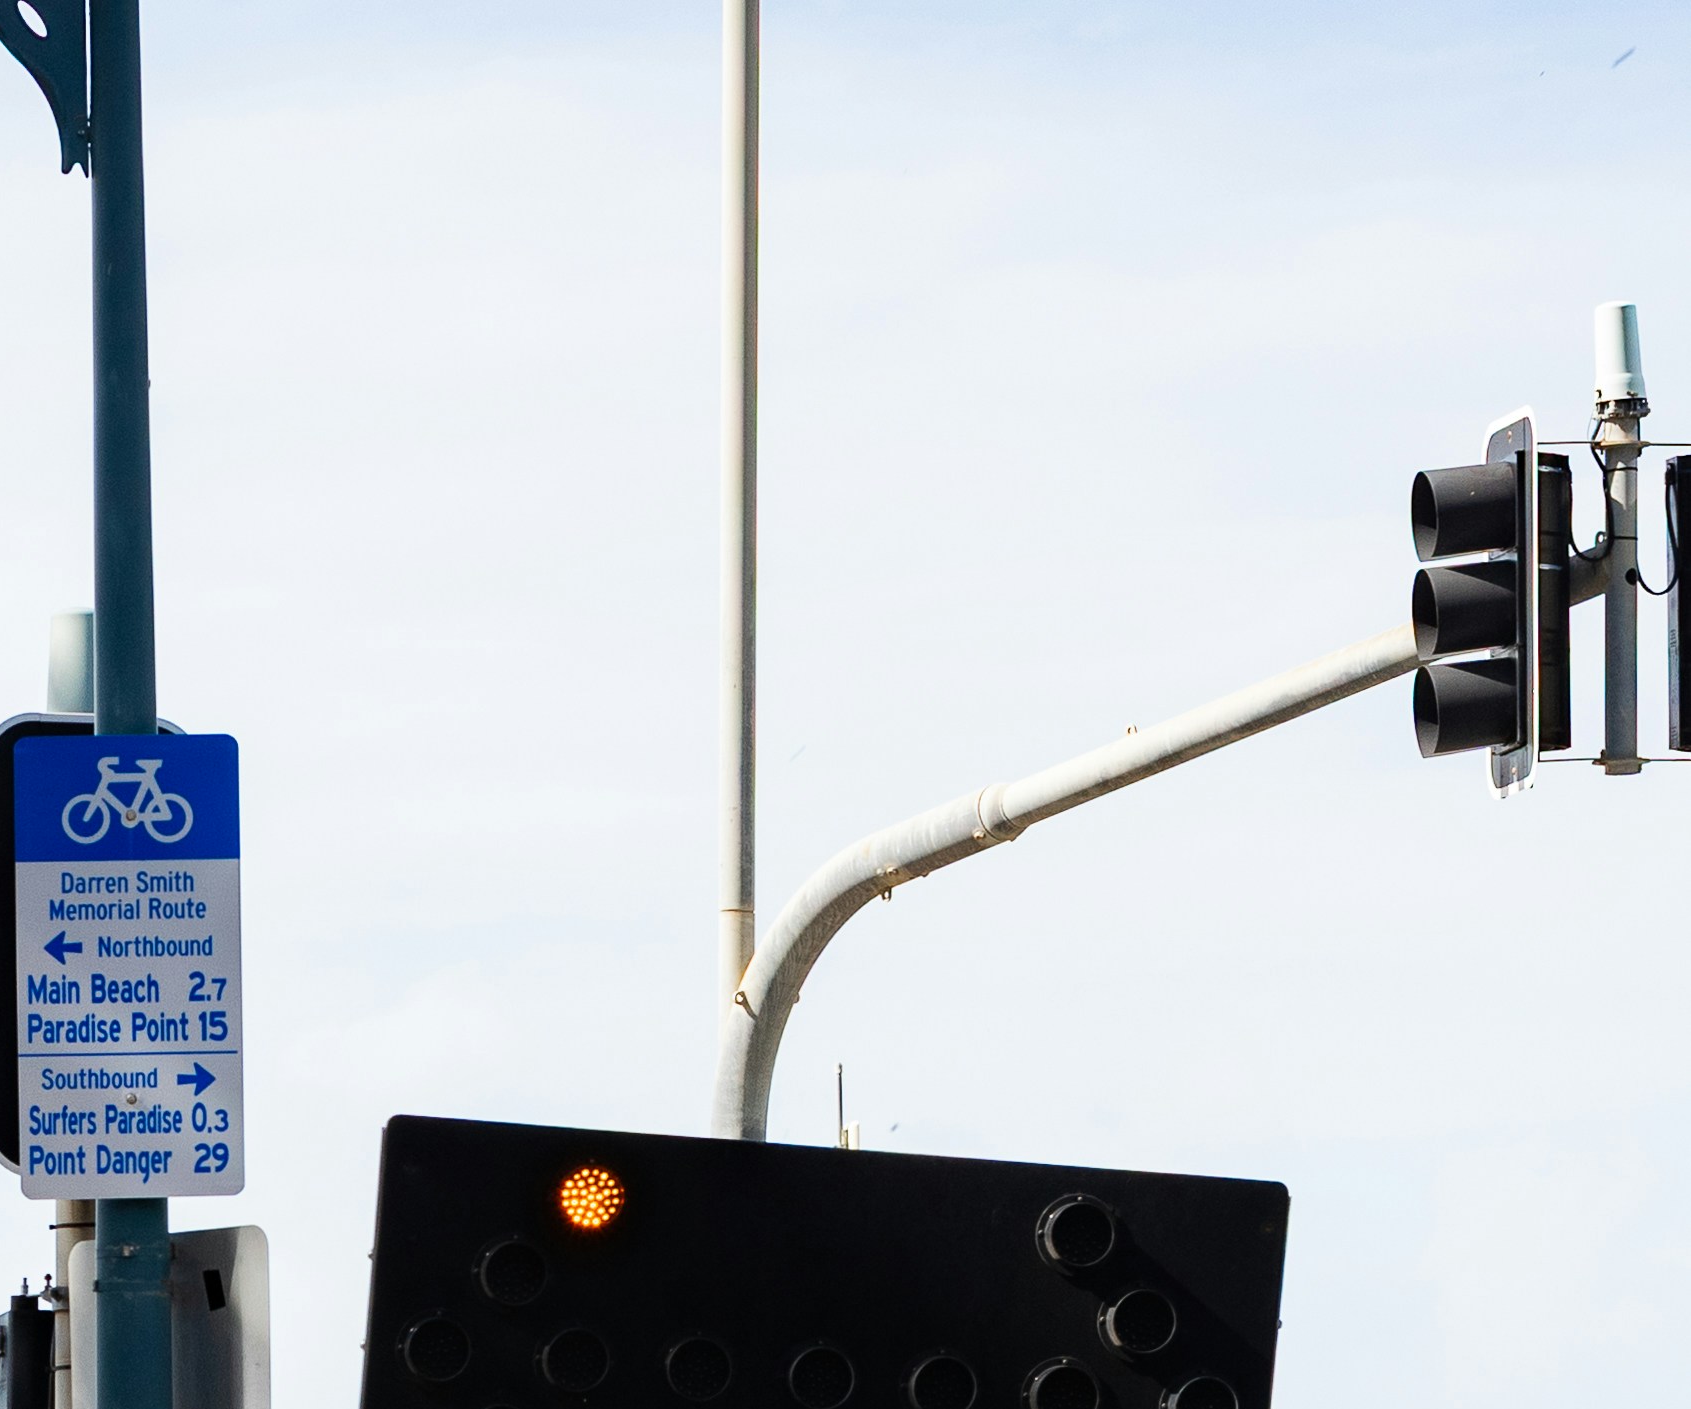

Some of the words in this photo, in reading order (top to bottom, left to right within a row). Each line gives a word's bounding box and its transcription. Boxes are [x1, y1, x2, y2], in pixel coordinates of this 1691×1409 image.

[61, 872, 128, 893] Darren
[136, 871, 194, 892] Smith
[49, 899, 140, 920] Memorial
[149, 897, 206, 919] Route
[98, 936, 213, 958] Northbound
[28, 973, 80, 1004] Main
[92, 973, 159, 1003] Beach
[188, 972, 227, 1002] 2.7
[27, 1012, 120, 1043] Paradise
[132, 1012, 188, 1042] Point
[199, 1011, 228, 1041] 15
[41, 1068, 158, 1090] Southbound
[29, 1105, 96, 1135] Surfers
[105, 1104, 182, 1134] Paradise
[192, 1103, 229, 1133] 0.3
[29, 1145, 85, 1175] Point
[96, 1145, 172, 1183] Danger
[194, 1143, 230, 1173] 29
